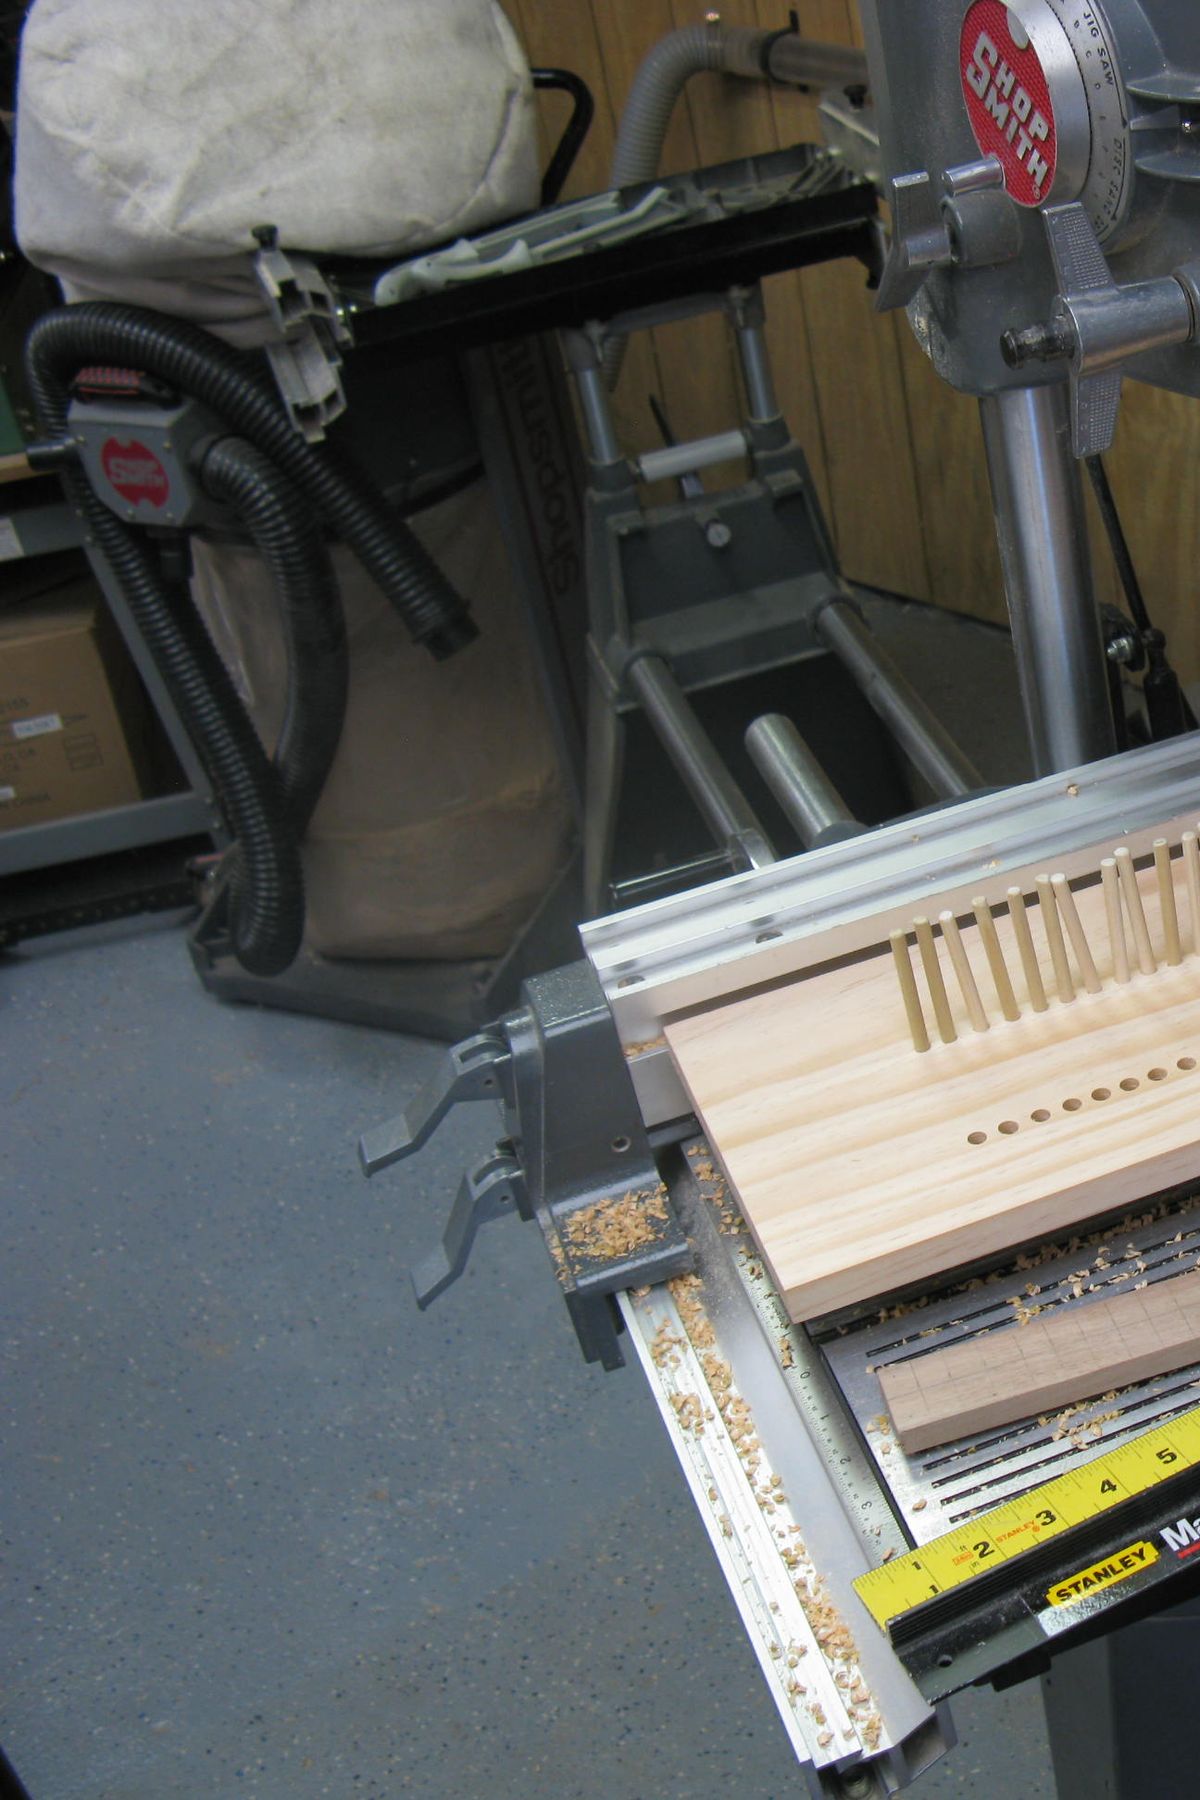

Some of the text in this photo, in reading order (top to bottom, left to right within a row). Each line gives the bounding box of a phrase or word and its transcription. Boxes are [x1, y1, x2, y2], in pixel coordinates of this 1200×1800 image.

[1083, 12, 1115, 85] JIG SAW
[861, 1501, 873, 1511] 3
[929, 1584, 939, 1595] 1
[973, 1541, 995, 1559] 2
[1036, 1509, 1057, 1526] 3
[1100, 1478, 1118, 1494] 4
[1156, 1447, 1177, 1465] 5
[995, 1519, 1036, 1543] STANLEY
[911, 1560, 922, 1572] 1
[1056, 1546, 1147, 1602] STANLEY
